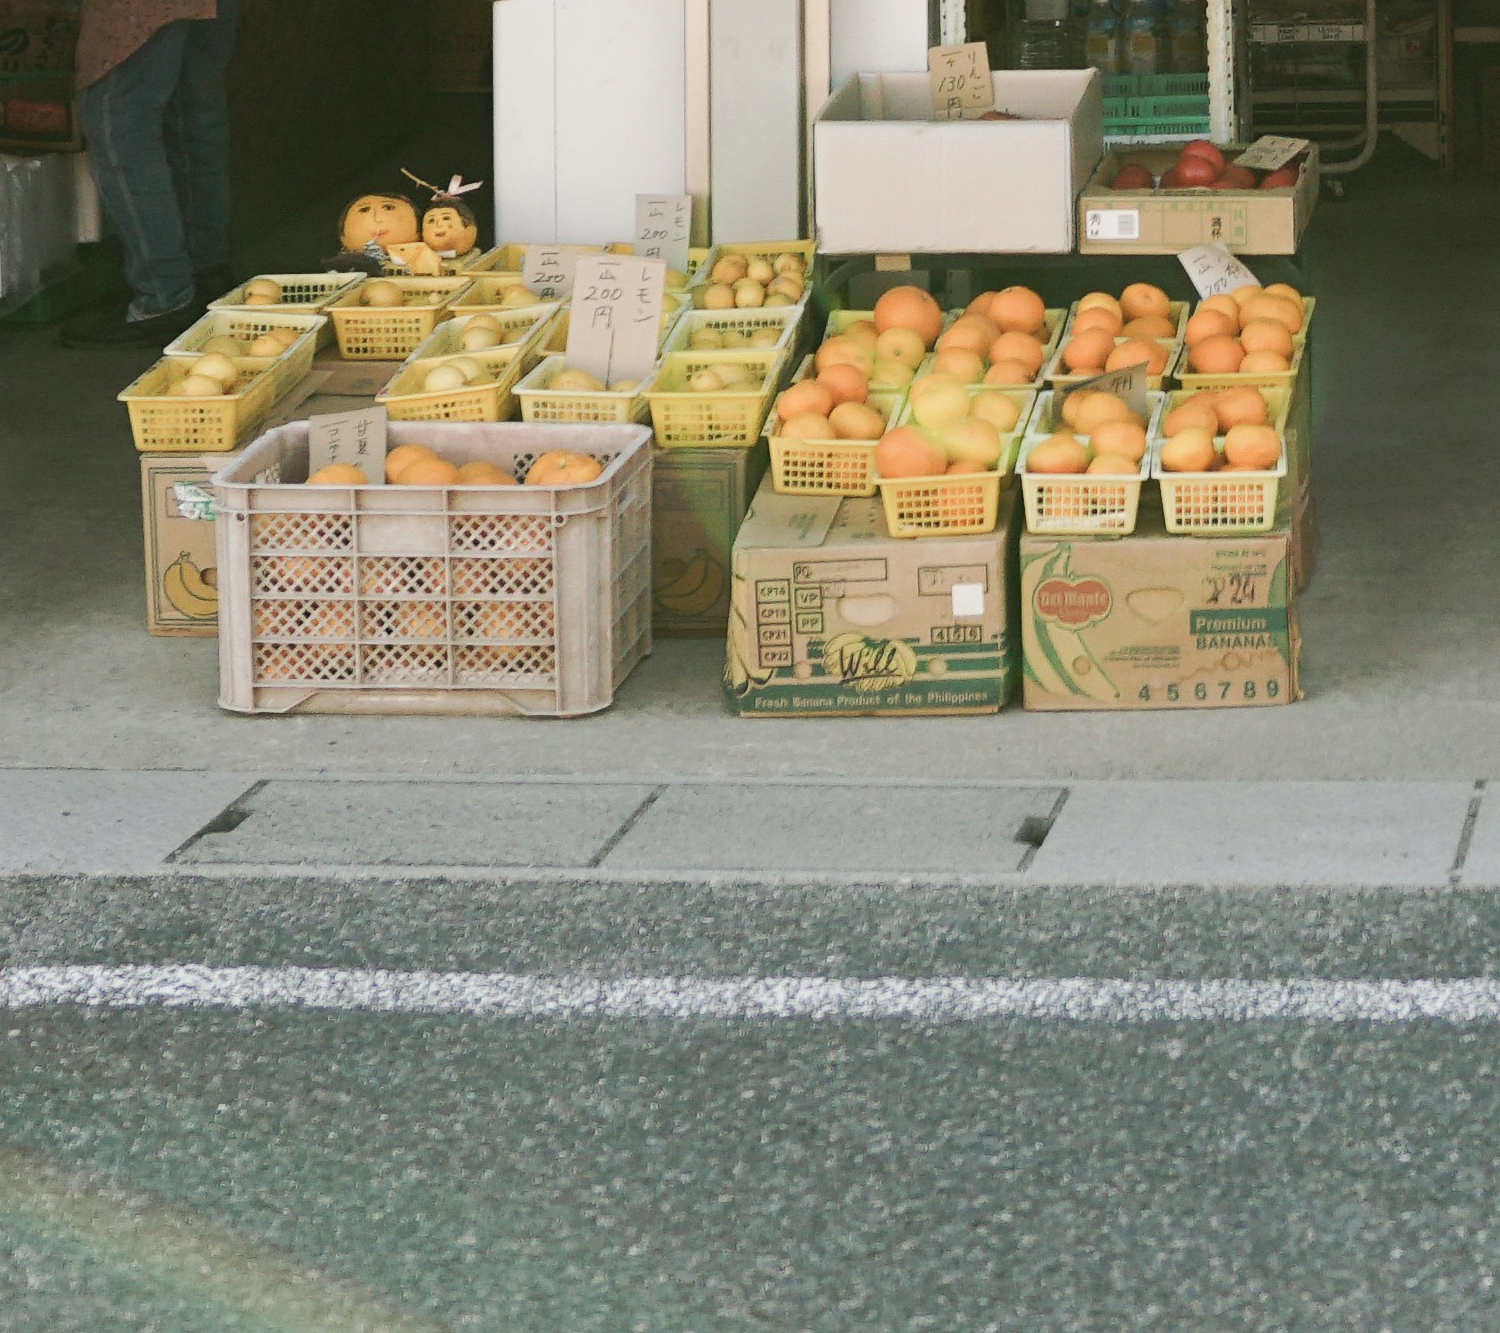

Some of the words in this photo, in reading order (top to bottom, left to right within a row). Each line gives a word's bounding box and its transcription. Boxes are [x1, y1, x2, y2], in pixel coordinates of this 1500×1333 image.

[938, 74, 965, 92] 130
[640, 229, 668, 240] 200
[597, 262, 620, 281] 一山
[583, 286, 624, 302] 200
[633, 267, 654, 323] レモン
[592, 305, 615, 329] 円
[1040, 591, 1060, 606] Del
[801, 617, 818, 629] PP
[1196, 616, 1266, 632] Premium
[839, 645, 898, 679] Will
[755, 697, 788, 708] Fresh
[792, 695, 832, 708] Banana
[837, 694, 880, 707] Product
[887, 693, 899, 705] of
[905, 692, 922, 704] the
[928, 690, 988, 705] Philippines
[1139, 684, 1150, 701] 4
[1167, 683, 1179, 701] 5
[1195, 683, 1207, 701] 6
[1218, 682, 1231, 700] 7
[1244, 680, 1256, 698] 8
[1267, 680, 1279, 698] 9
